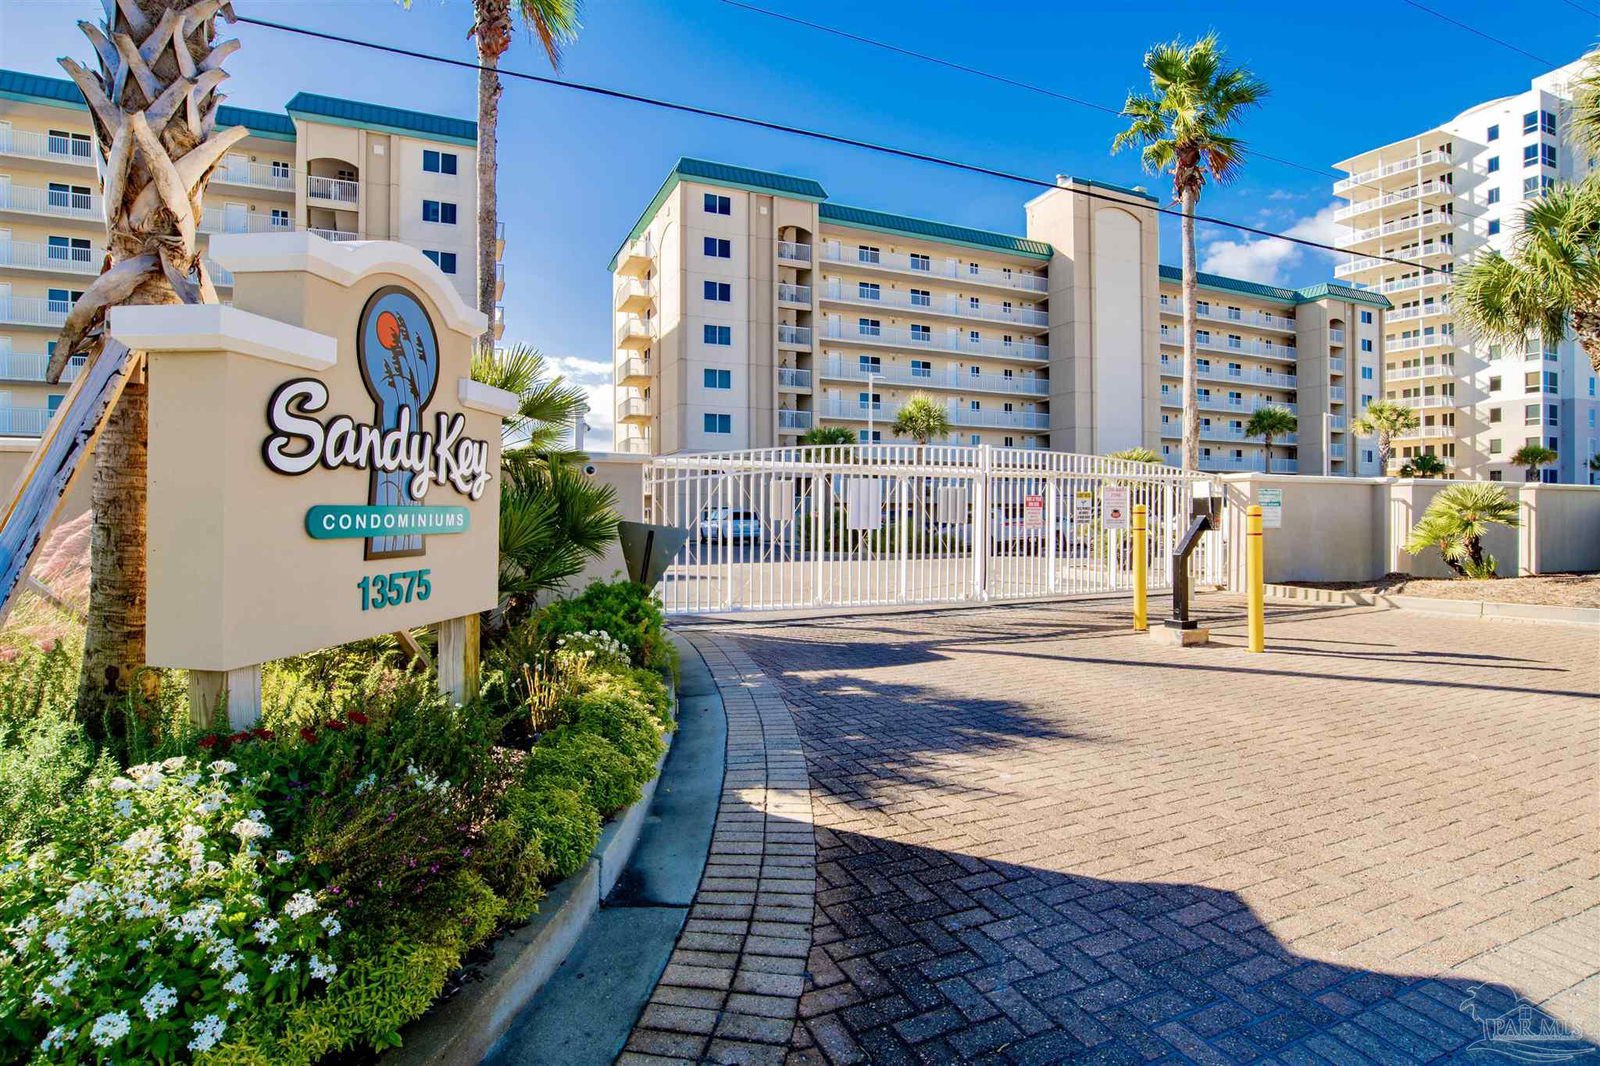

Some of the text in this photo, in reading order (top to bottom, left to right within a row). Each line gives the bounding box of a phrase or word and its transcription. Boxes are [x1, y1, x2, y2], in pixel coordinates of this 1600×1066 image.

[262, 378, 492, 500] Sandy Key
[322, 513, 465, 531] CONDOMINIUMS
[357, 568, 432, 611] 13575
